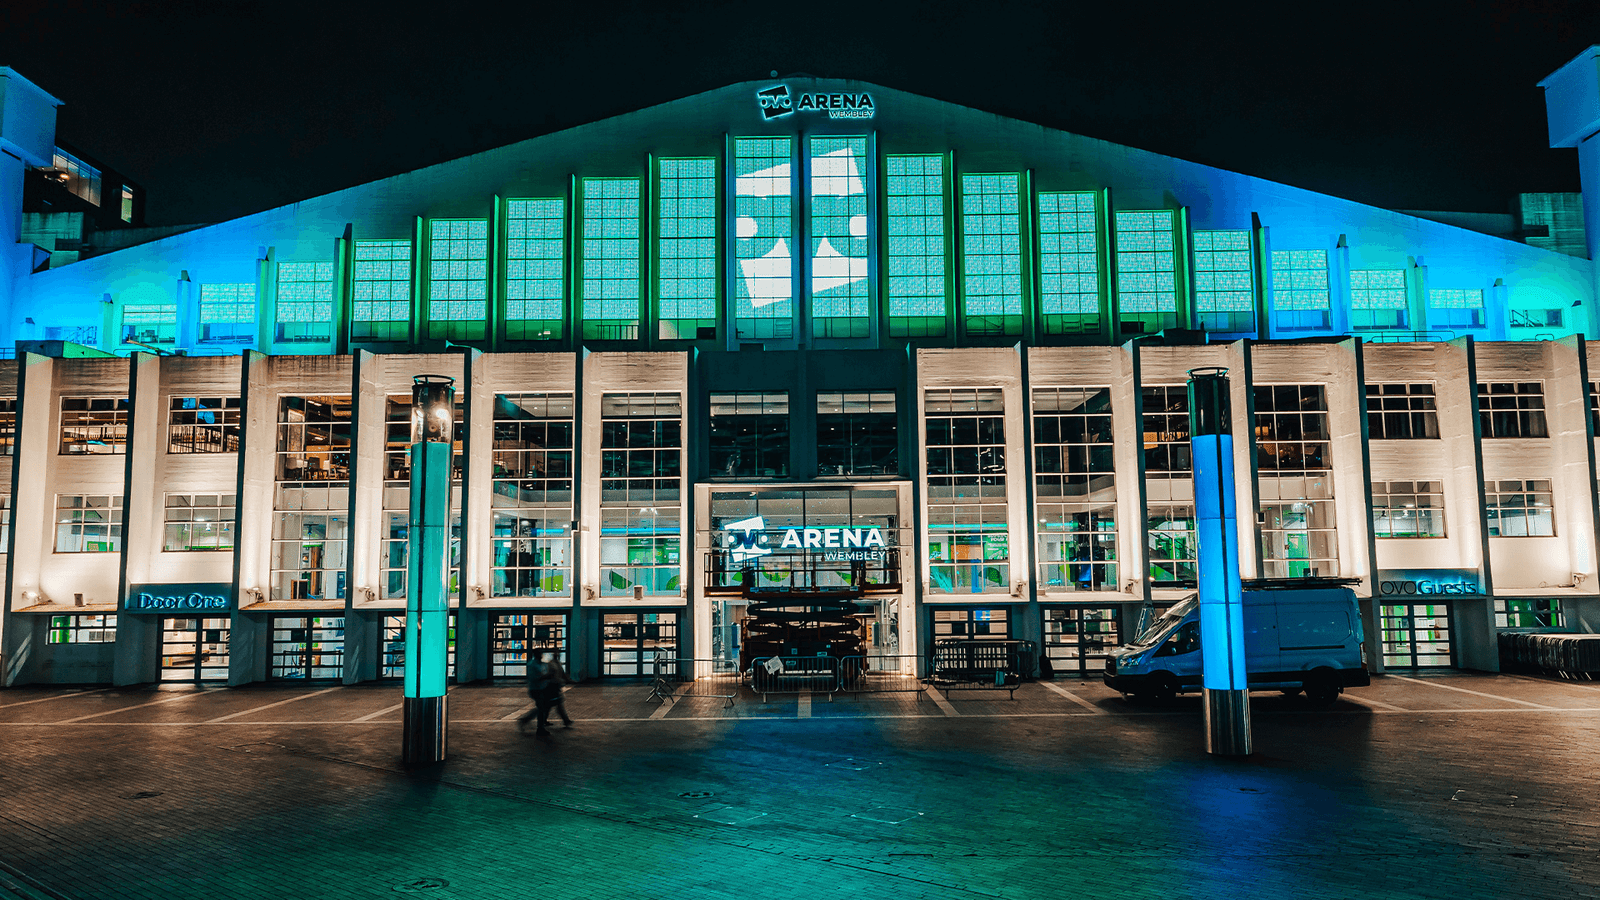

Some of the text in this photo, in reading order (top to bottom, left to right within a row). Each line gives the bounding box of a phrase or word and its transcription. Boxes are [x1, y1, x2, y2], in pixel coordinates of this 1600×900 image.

[798, 92, 874, 110] ARENA
[829, 110, 874, 118] WEMBLEY
[781, 528, 886, 548] ARENA
[824, 551, 886, 561] WEMBLEY
[138, 592, 226, 609] Door One
